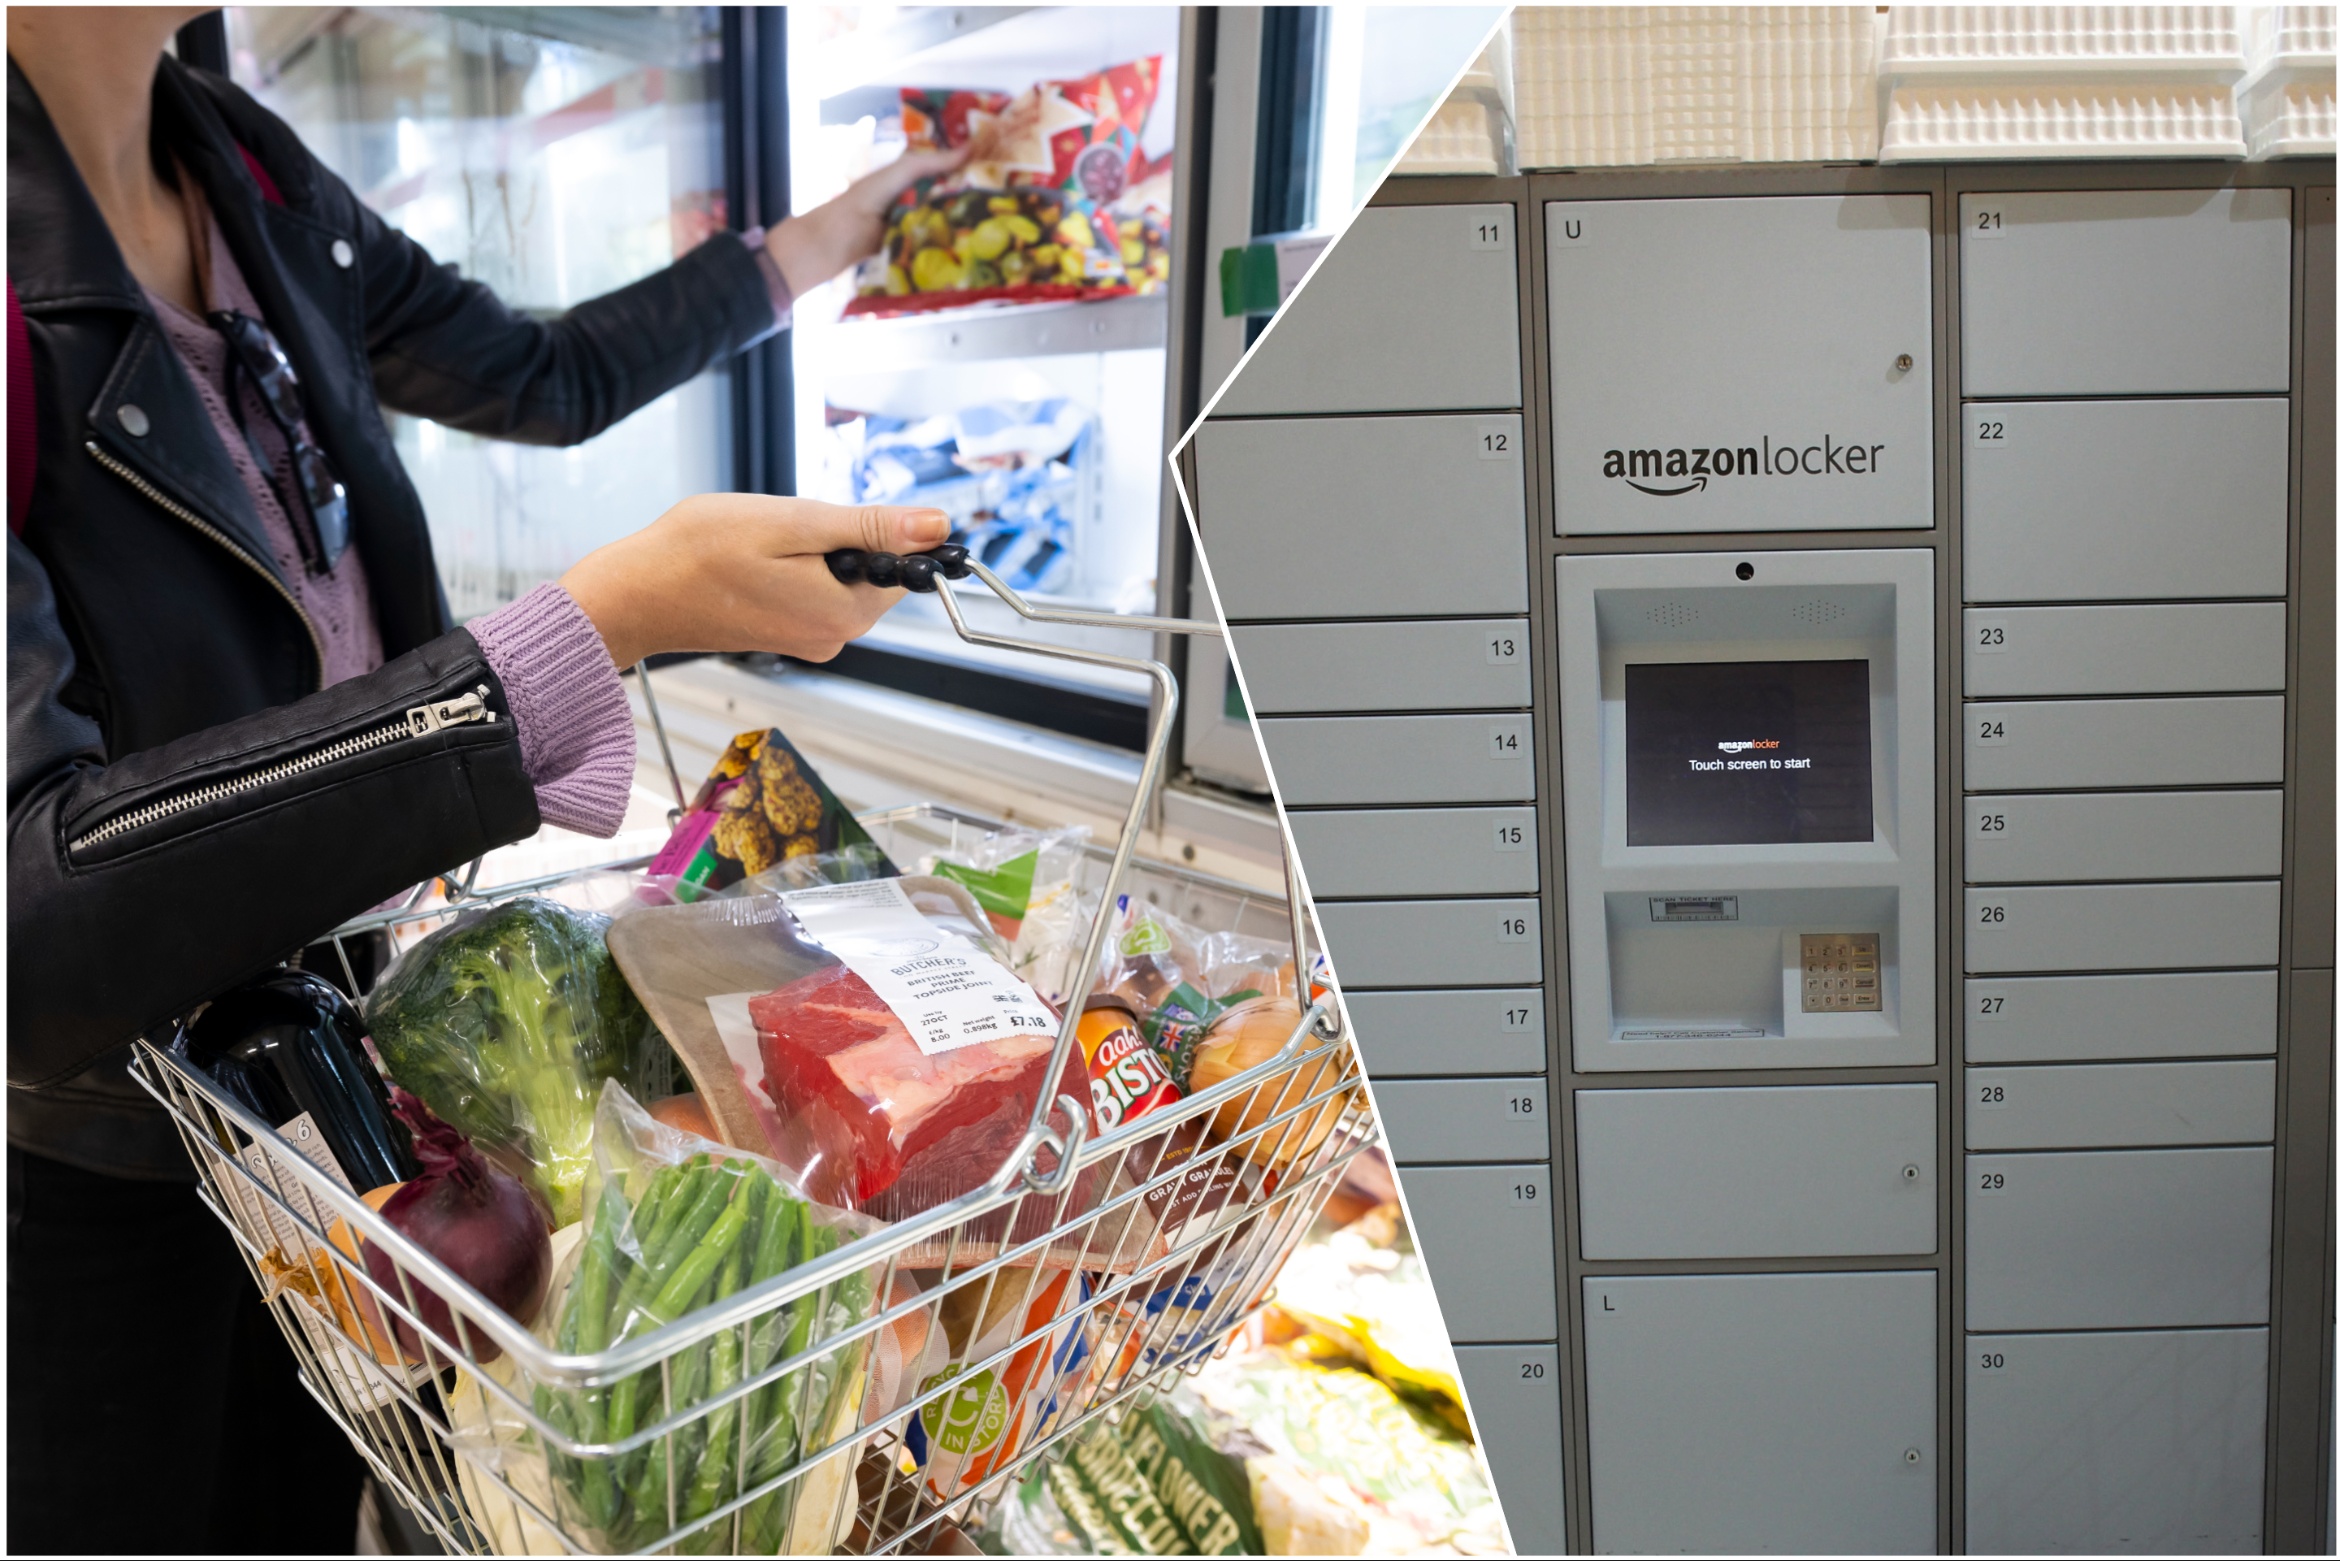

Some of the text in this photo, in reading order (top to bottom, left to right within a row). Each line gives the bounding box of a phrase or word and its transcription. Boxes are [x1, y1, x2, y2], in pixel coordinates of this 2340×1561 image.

[1979, 212, 2001, 229] 21
[1478, 225, 1498, 241] 11
[1566, 220, 1580, 239] U
[1980, 423, 2003, 439] 22
[1484, 435, 1507, 450] 12
[1603, 434, 1885, 478] amazonlocker
[1981, 628, 2004, 644] 23
[1491, 640, 1515, 656] 13
[1981, 722, 2004, 738] 24
[1495, 735, 1518, 750] 14
[1718, 739, 1780, 750] amazonlocker
[1689, 758, 1811, 771] Touch screen to start
[1981, 815, 2004, 831] 25
[1498, 828, 1522, 843] 15
[1981, 907, 2004, 922] 26
[1503, 919, 1526, 934] 16
[891, 957, 967, 976] BUTCHER'S
[907, 970, 975, 987] BRITISH BEEF
[931, 978, 965, 988] PRIME
[913, 985, 961, 1000] TOPSIDE
[1981, 998, 2004, 1013] 27
[974, 1015, 995, 1025] weight
[1010, 1016, 1047, 1028] £7.18
[1506, 1010, 1529, 1025] 17
[931, 1033, 950, 1044] 8.00
[1099, 1026, 1144, 1067] aah!
[1089, 1047, 1173, 1135] BISTO
[1981, 1087, 2004, 1102] 28
[1510, 1098, 1533, 1113] 18
[296, 1119, 311, 1141] 6
[1166, 1150, 1183, 1160] ESTD
[1189, 1166, 1234, 1183] GRAULES
[1981, 1174, 2004, 1189] 29
[1182, 1192, 1197, 1203] ADD
[1514, 1185, 1537, 1199] 19
[1604, 1295, 1615, 1311] L
[1981, 1353, 2004, 1369] 30
[1522, 1364, 1544, 1379] 20
[946, 1433, 964, 1449] IN
